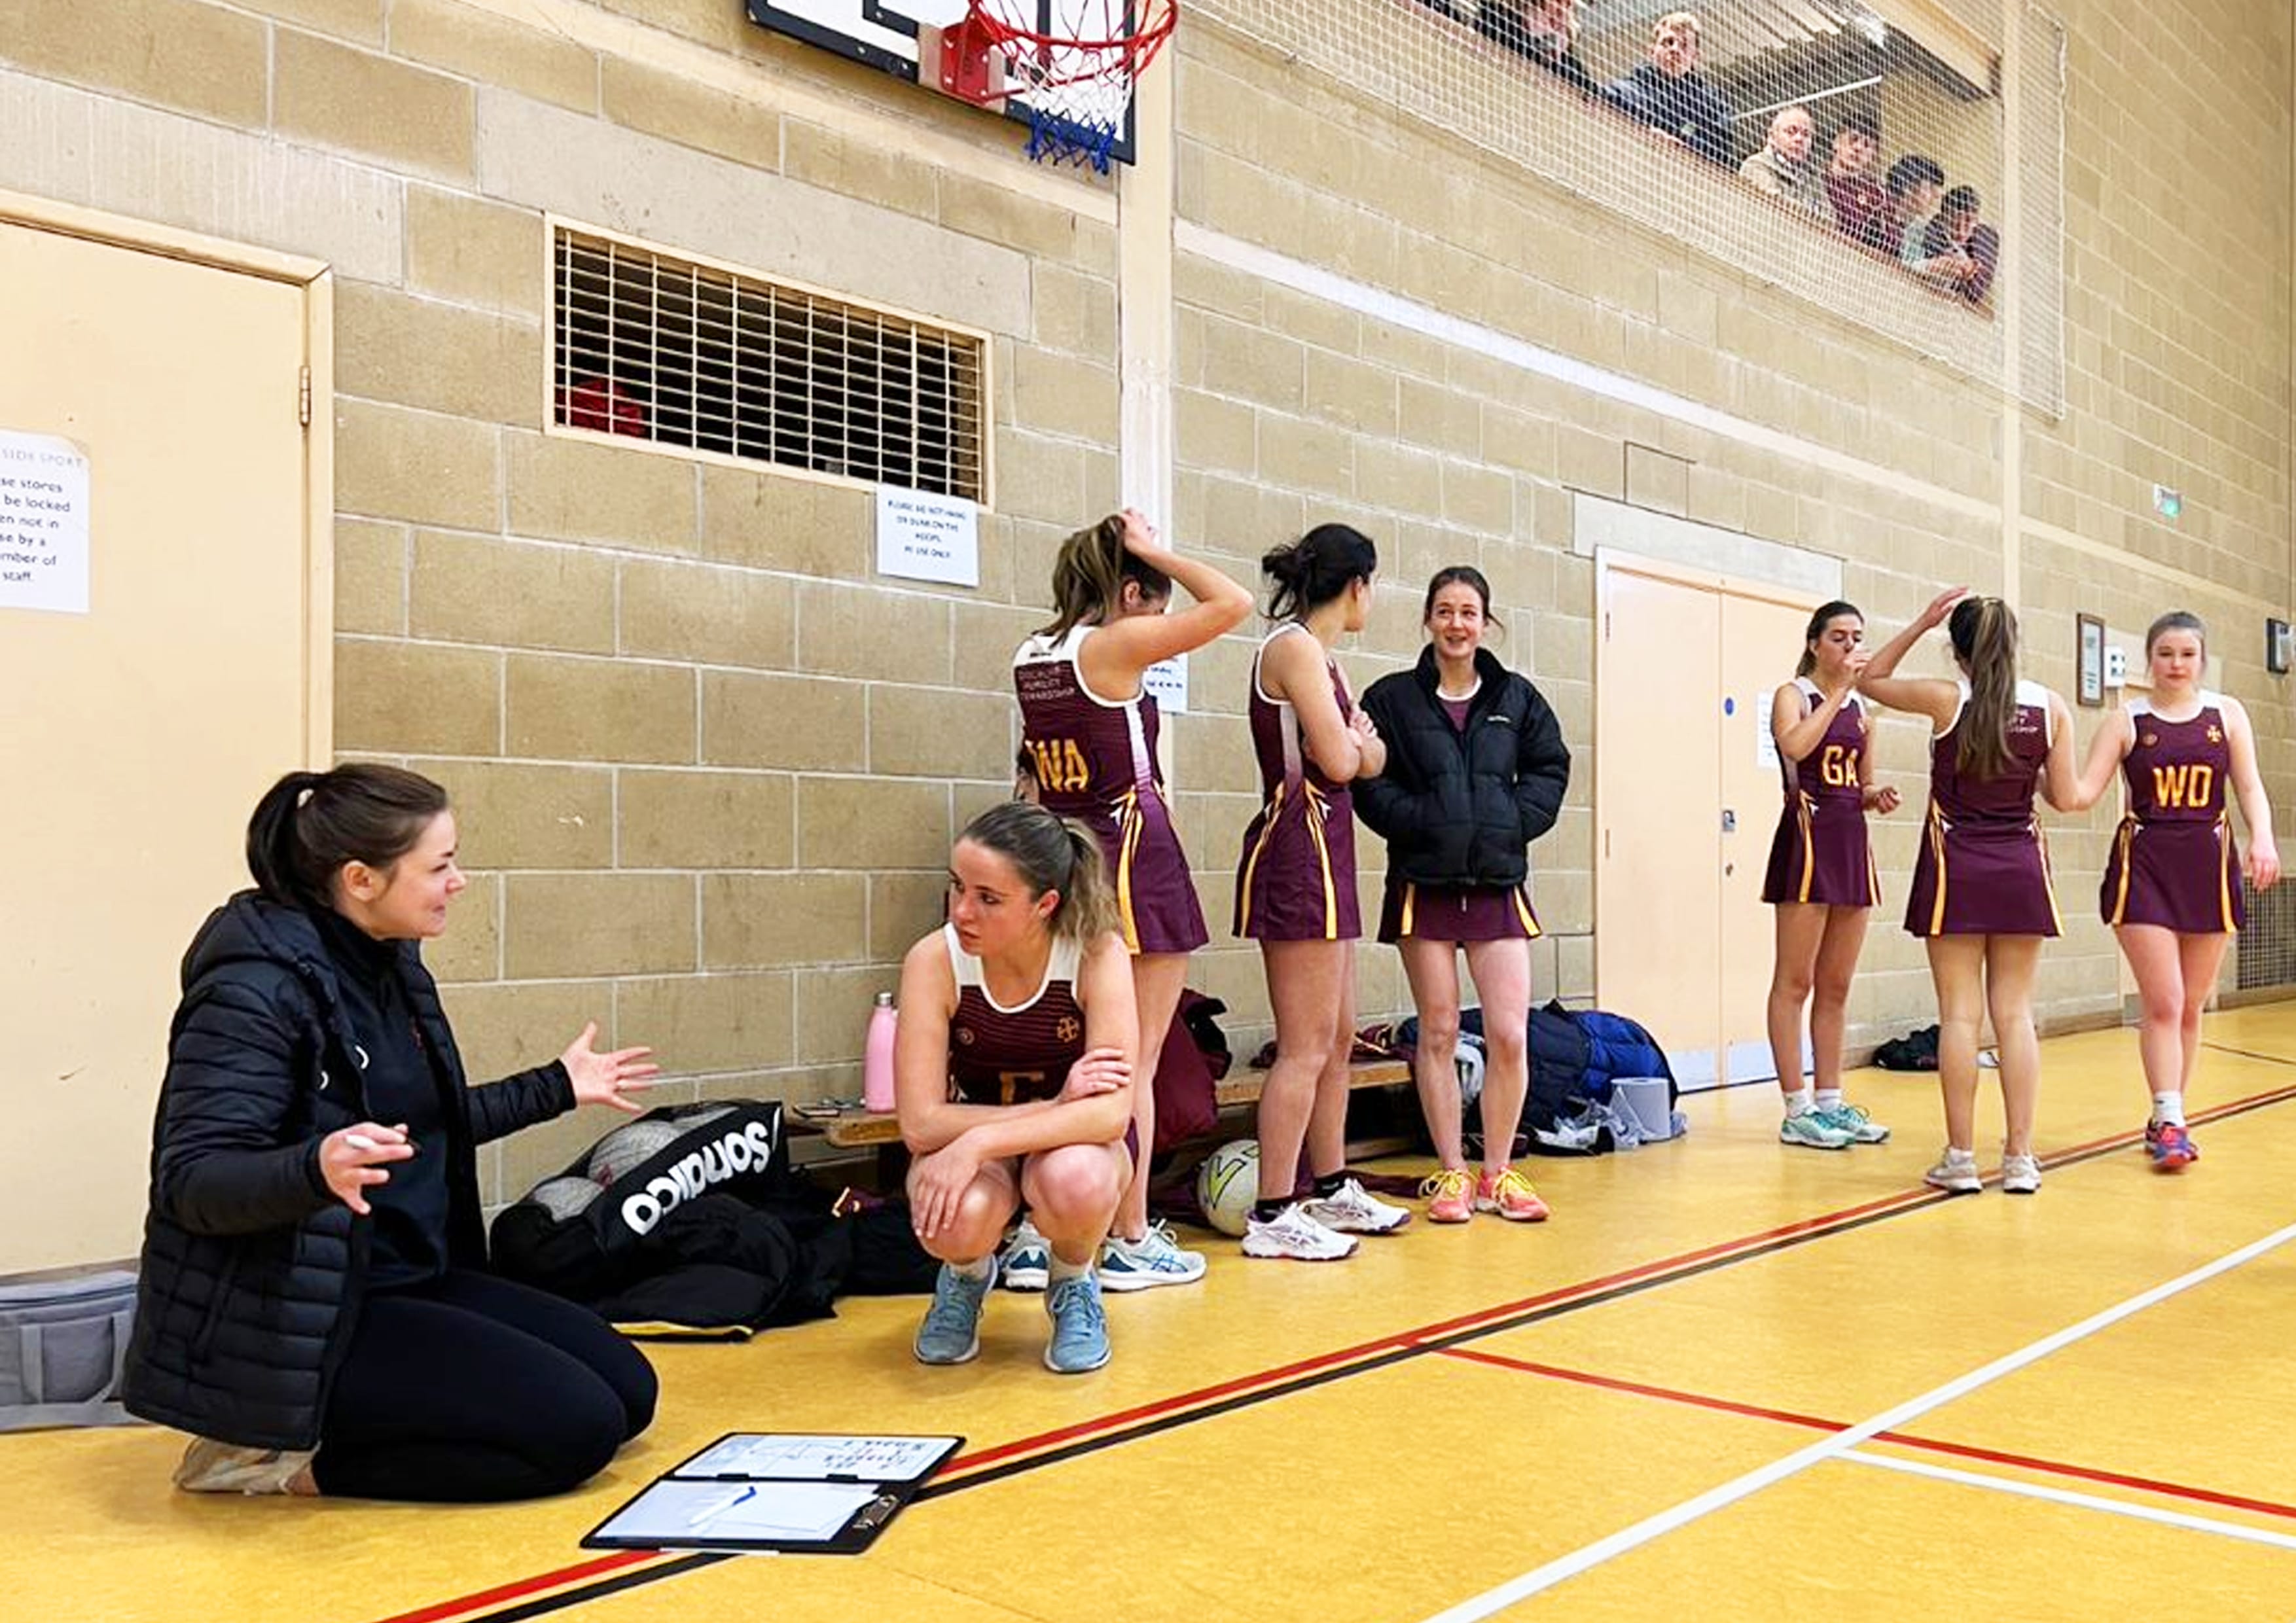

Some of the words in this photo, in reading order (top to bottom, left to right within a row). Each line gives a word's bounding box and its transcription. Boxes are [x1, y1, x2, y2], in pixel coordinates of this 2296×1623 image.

[20, 480, 63, 493] stores
[4, 493, 21, 507] be
[26, 496, 71, 512] locked
[19, 517, 43, 528] not
[18, 533, 33, 547] by
[42, 555, 57, 565] of
[1024, 740, 1089, 793] WA
[1822, 744, 1859, 787] GA
[2152, 764, 2213, 808] WD
